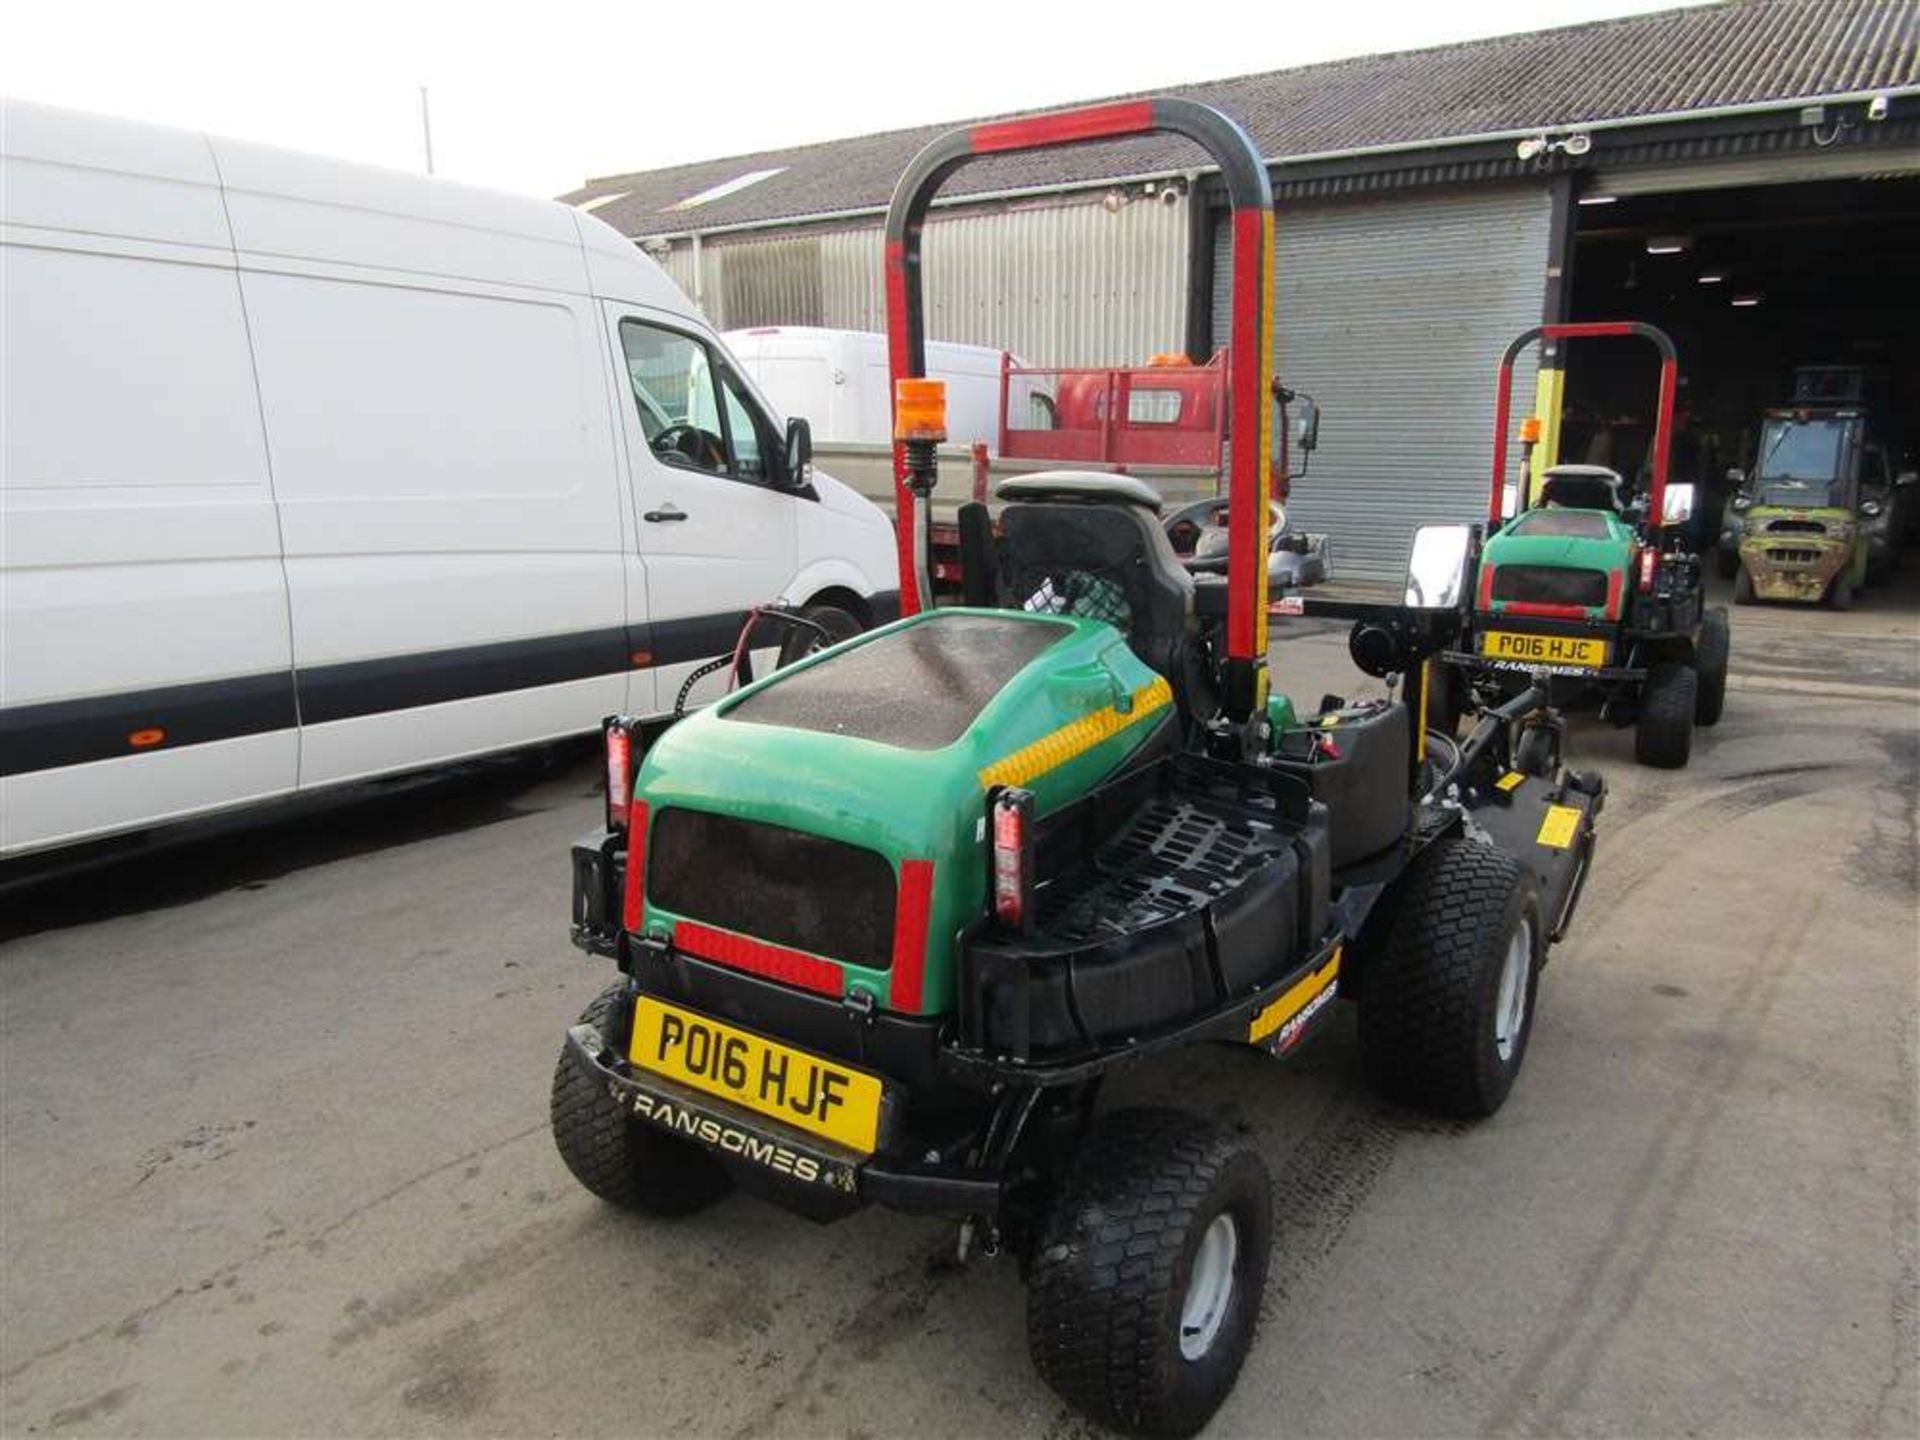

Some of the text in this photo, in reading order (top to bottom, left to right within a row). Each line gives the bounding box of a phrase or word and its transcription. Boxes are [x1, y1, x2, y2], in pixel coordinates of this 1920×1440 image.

[1494, 660, 1584, 677] RANSMES
[1499, 635, 1591, 660] PO16 HJC
[658, 1013, 851, 1123] PO16 HJF
[633, 1094, 821, 1184] RANSOMES
